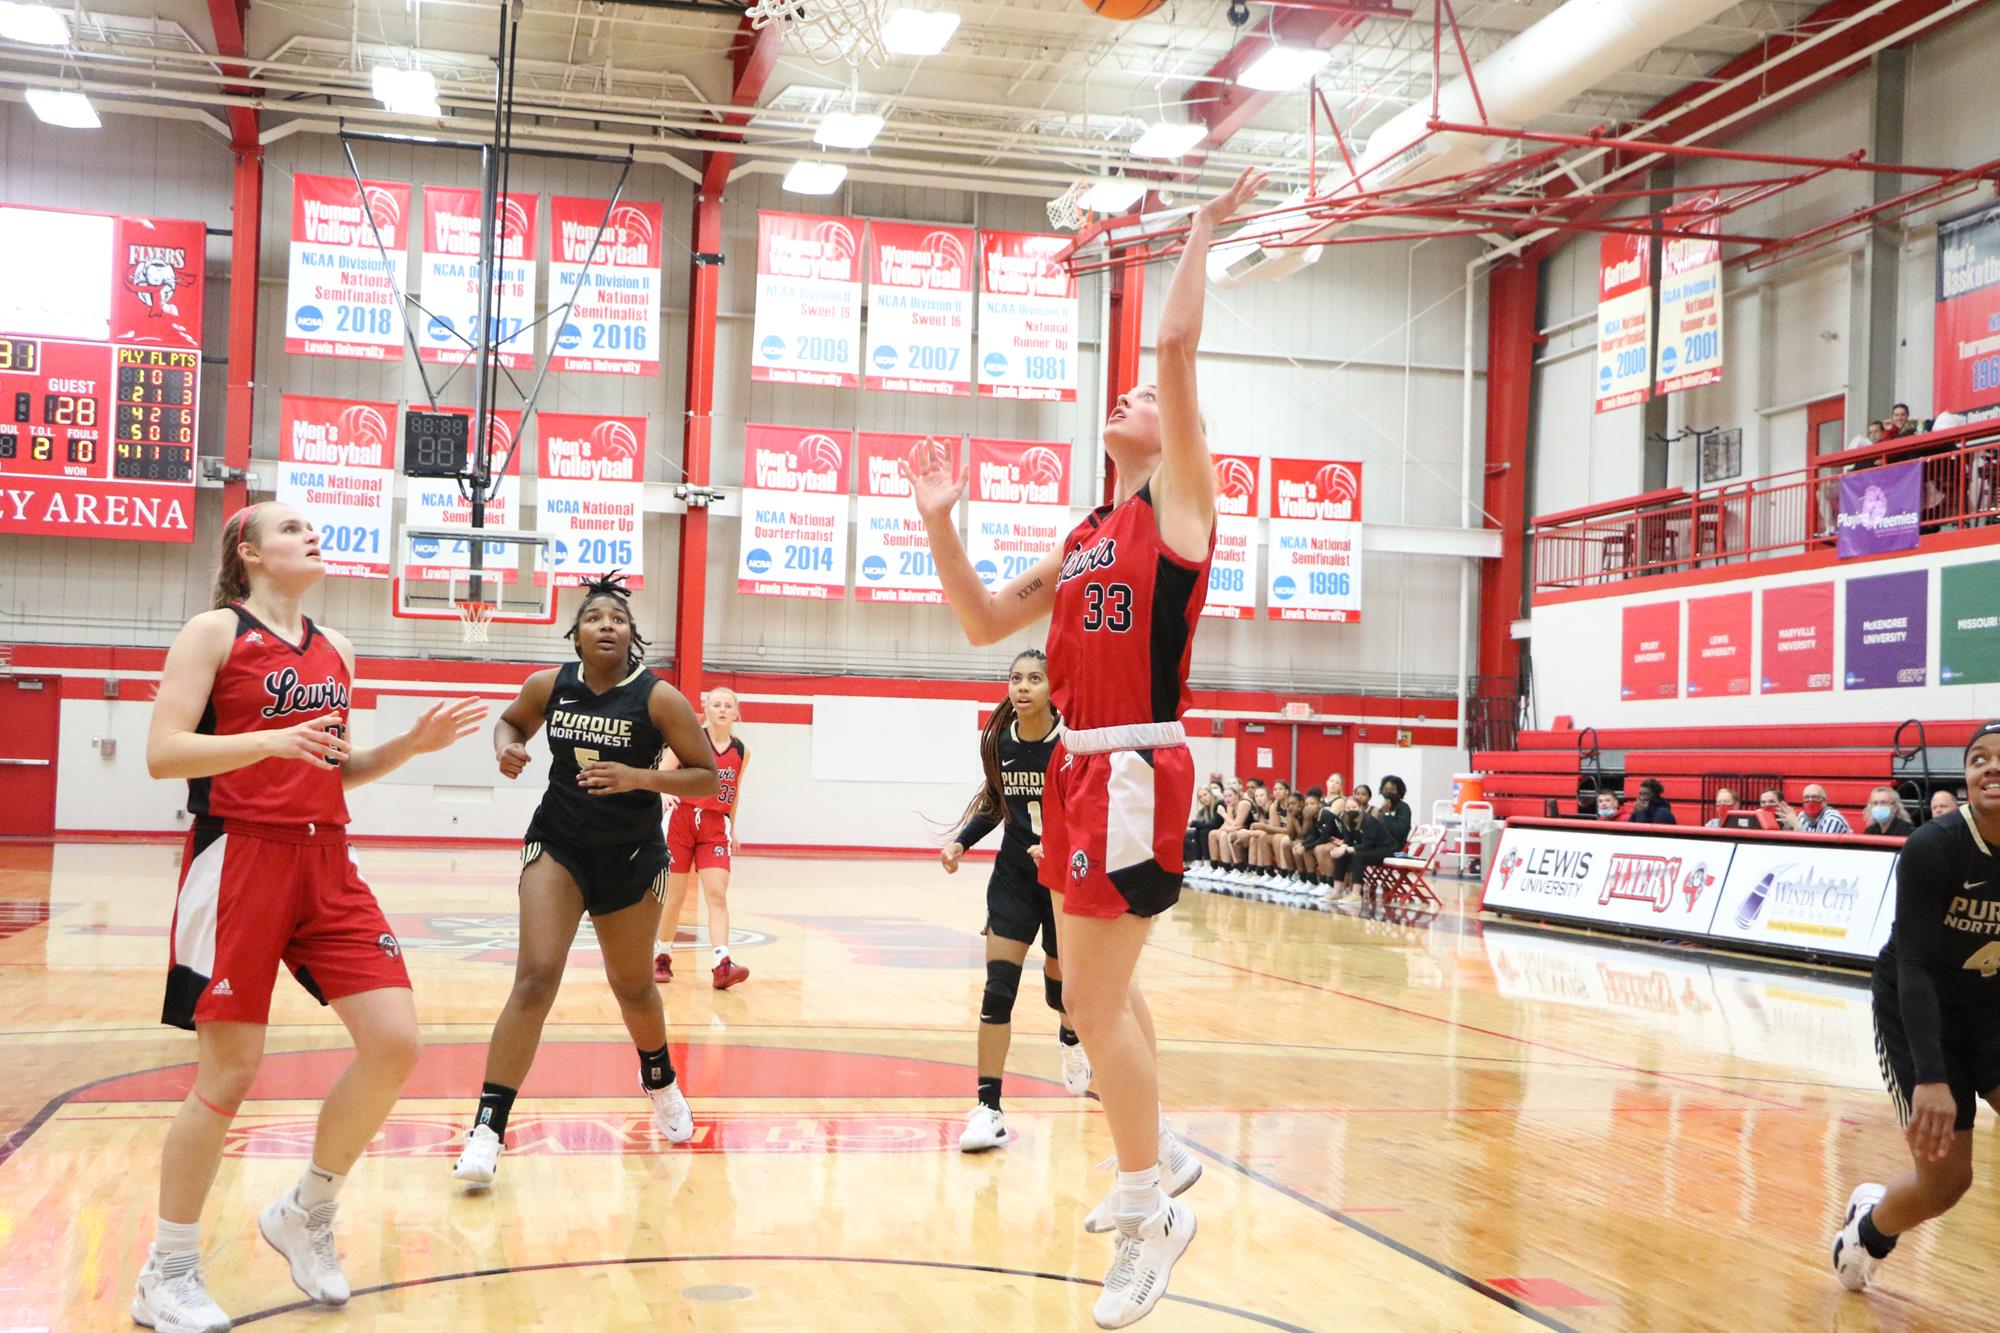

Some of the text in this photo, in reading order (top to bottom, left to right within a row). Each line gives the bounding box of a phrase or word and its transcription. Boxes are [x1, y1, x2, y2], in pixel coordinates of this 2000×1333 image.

[435, 212, 502, 234] Womes
[436, 228, 523, 257] Volleball
[129, 245, 185, 268] FLYERS
[302, 252, 334, 267] NCAA
[339, 255, 386, 271] Division
[341, 272, 392, 287] Nationa
[433, 263, 465, 278] NCAA
[880, 262, 961, 290] Volleyball
[513, 283, 523, 297] 16
[596, 274, 638, 289] Division
[315, 286, 393, 305] Semifinalist
[598, 290, 648, 305] National
[878, 294, 906, 307] NCAA
[911, 297, 951, 311] Division
[337, 305, 391, 334] 2018
[574, 305, 648, 321] Semifinalist
[912, 313, 946, 327] Sweet
[1025, 321, 1068, 333] National
[593, 324, 646, 350] 2016
[1014, 336, 1051, 349] Runner
[797, 336, 848, 363] 2009
[1685, 330, 1718, 364] 2001
[120, 350, 195, 367] PLY FL PTS
[908, 345, 960, 371] 2007
[1617, 347, 1646, 378] 2000
[1025, 355, 1066, 381] 1981
[48, 378, 96, 394] GUEST
[67, 429, 98, 439] FOULS
[293, 420, 337, 441] Men's
[34, 437, 92, 462] 2 0
[293, 438, 382, 466] Volleyball
[548, 437, 591, 456] Men's
[549, 455, 632, 481] Volleyball
[756, 449, 798, 469] Men's
[64, 466, 87, 475] WON
[756, 465, 837, 492] Volleyball
[980, 462, 1020, 481] Men's
[290, 472, 382, 492] NCAA National
[980, 479, 1058, 504] Volleyball
[1278, 479, 1316, 498] Men's
[307, 489, 380, 508] Semifinalist
[422, 493, 453, 507] NCAA
[547, 500, 634, 516] NCAA National
[43, 492, 188, 529] ARENA
[756, 510, 834, 527] NCAA National
[1278, 498, 1352, 520] Volleyball
[571, 516, 634, 533] Runner Up
[871, 517, 899, 530] NCAA
[981, 522, 1056, 538] NCAA National
[321, 525, 379, 553] 2021
[755, 526, 833, 542] Quarterfinalist
[883, 534, 929, 547] Semifina
[1280, 536, 1350, 551] NCAA National
[578, 538, 632, 565] 2015
[784, 545, 833, 571] 2014
[1292, 552, 1350, 566] Semifinalist
[899, 551, 938, 576] 201
[1210, 567, 1244, 592] 998
[1308, 572, 1350, 596] 1996
[1084, 583, 1132, 633] 33
[1779, 626, 1815, 639] MARYVILLE
[1958, 616, 1997, 630] MISSOURI
[1778, 640, 1816, 652] UNIVERSITY
[1863, 631, 1907, 644] UNIVERSITY
[262, 667, 349, 718] Lewis
[551, 710, 632, 736] PURDUE
[550, 726, 631, 748] NORTHWEST
[1001, 772, 1045, 786] PURD
[1526, 848, 1593, 880] LEWIS
[1520, 877, 1583, 898] UNIVERSITY
[1598, 853, 1682, 913] FLYERS
